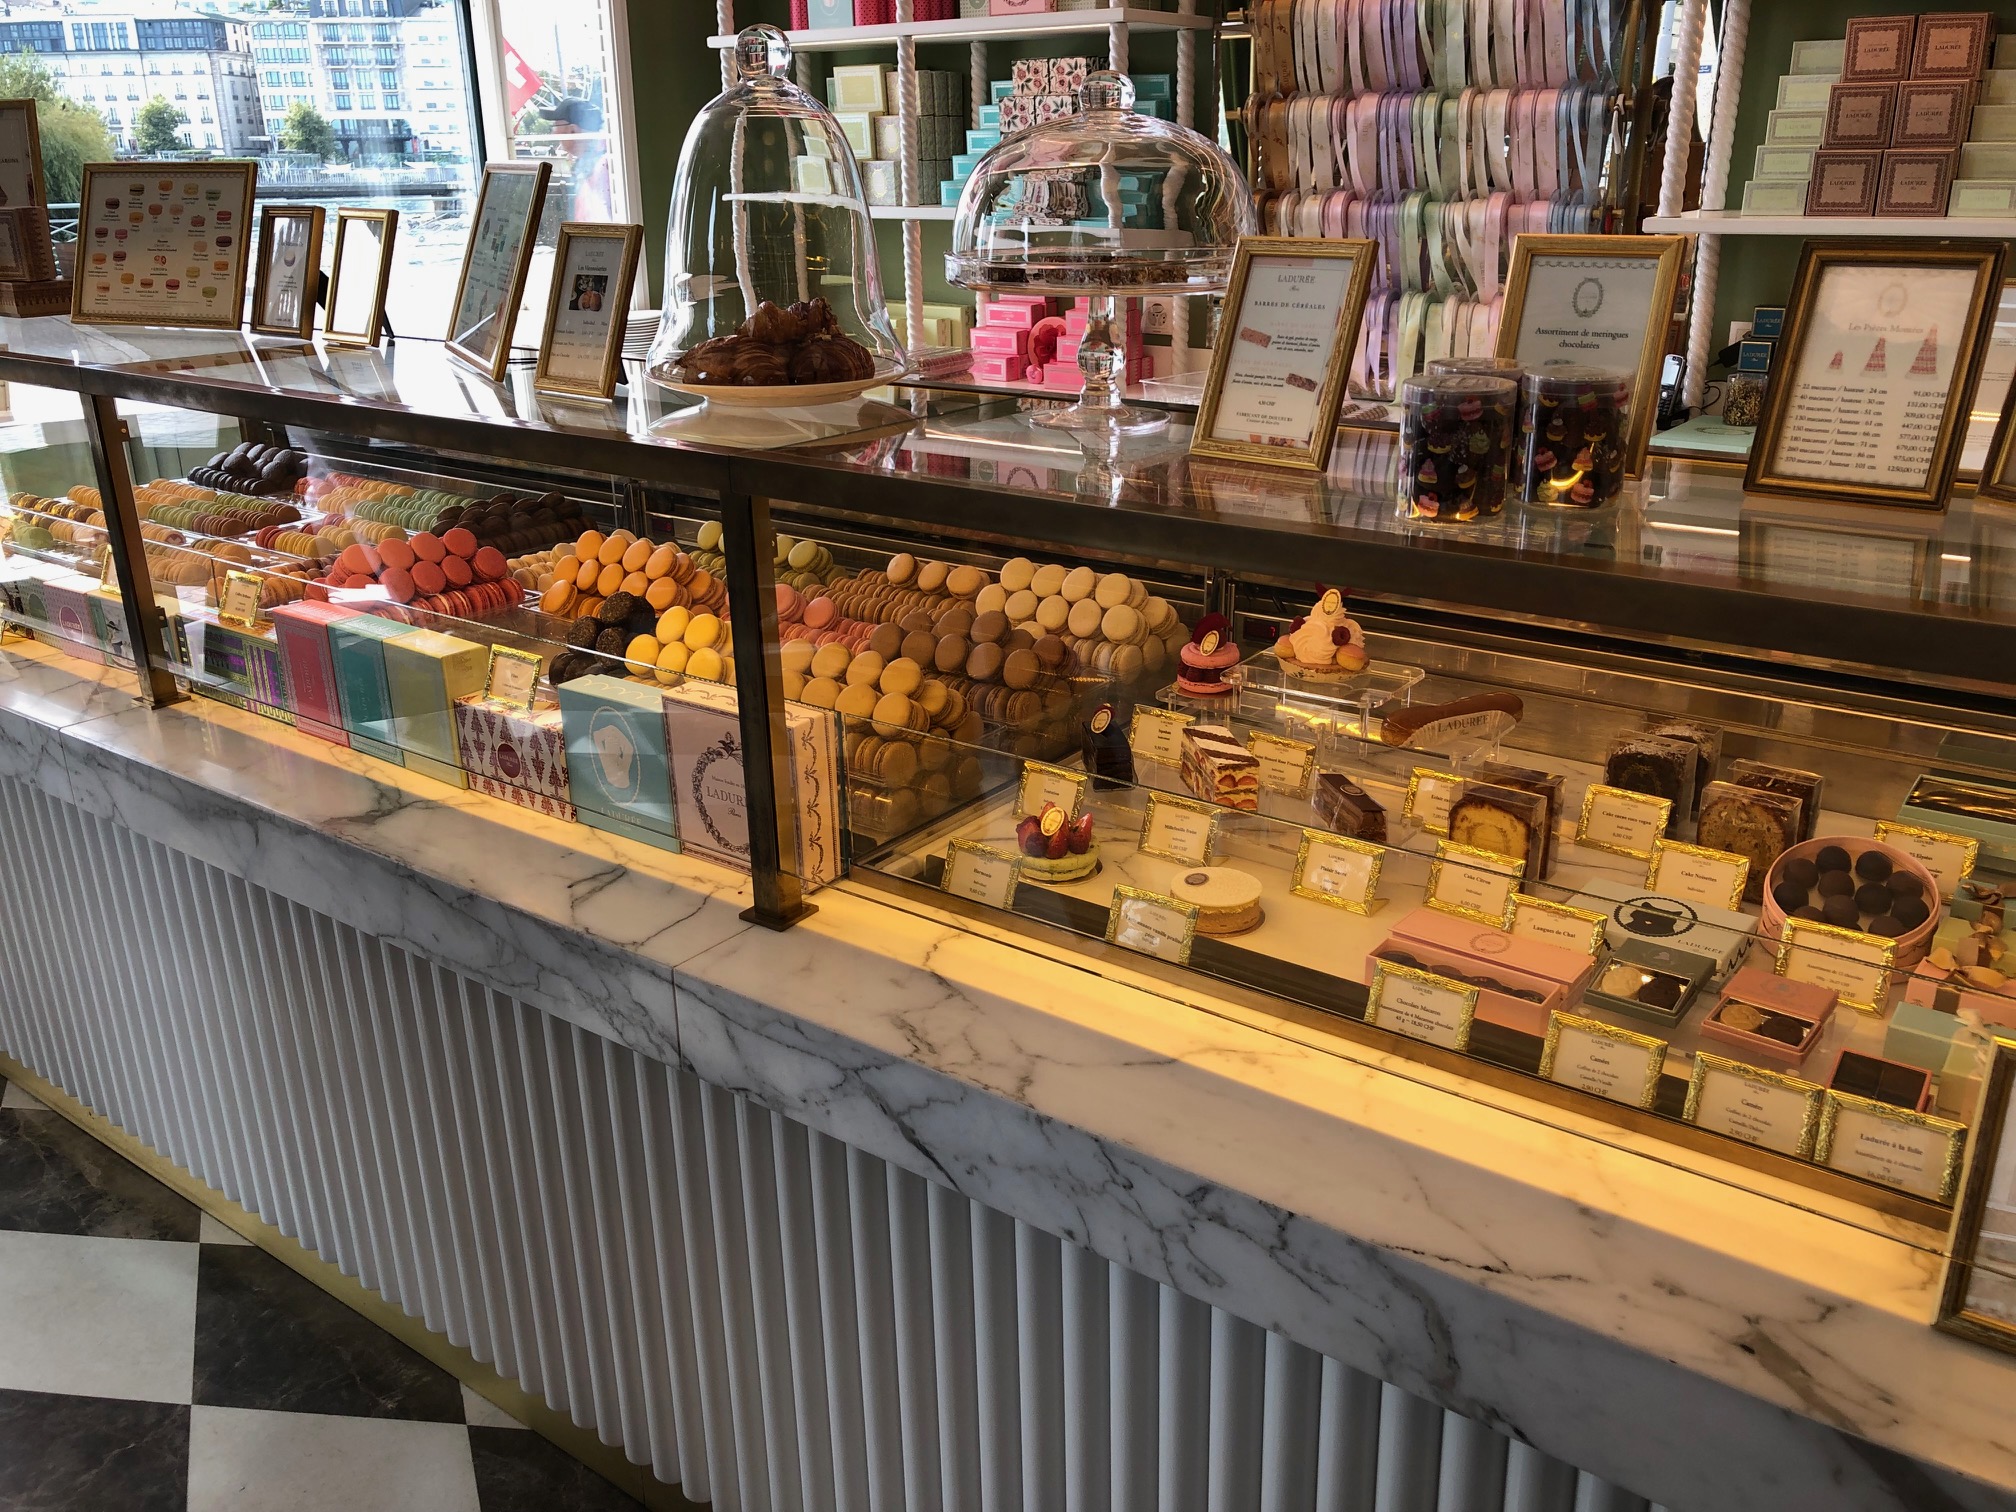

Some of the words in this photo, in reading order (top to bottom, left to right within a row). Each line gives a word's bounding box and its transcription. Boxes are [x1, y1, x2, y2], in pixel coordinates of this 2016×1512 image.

[1278, 274, 1316, 284] LADURÉE
[1849, 322, 1861, 331] Les
[1535, 327, 1579, 337] Assortiment
[1581, 328, 1590, 337] de
[1591, 330, 1629, 341] meringues
[1559, 339, 1600, 350] chocolatées
[706, 786, 746, 807] LADUR
[1463, 873, 1476, 881] Cake
[1477, 876, 1491, 885] Citron
[1695, 874, 1717, 882] Noisettes
[1532, 924, 1554, 935] Langues
[1562, 930, 1576, 938] Chat
[1396, 998, 1419, 1009] Chocolats
[1860, 1133, 1890, 1147] Ladurée
